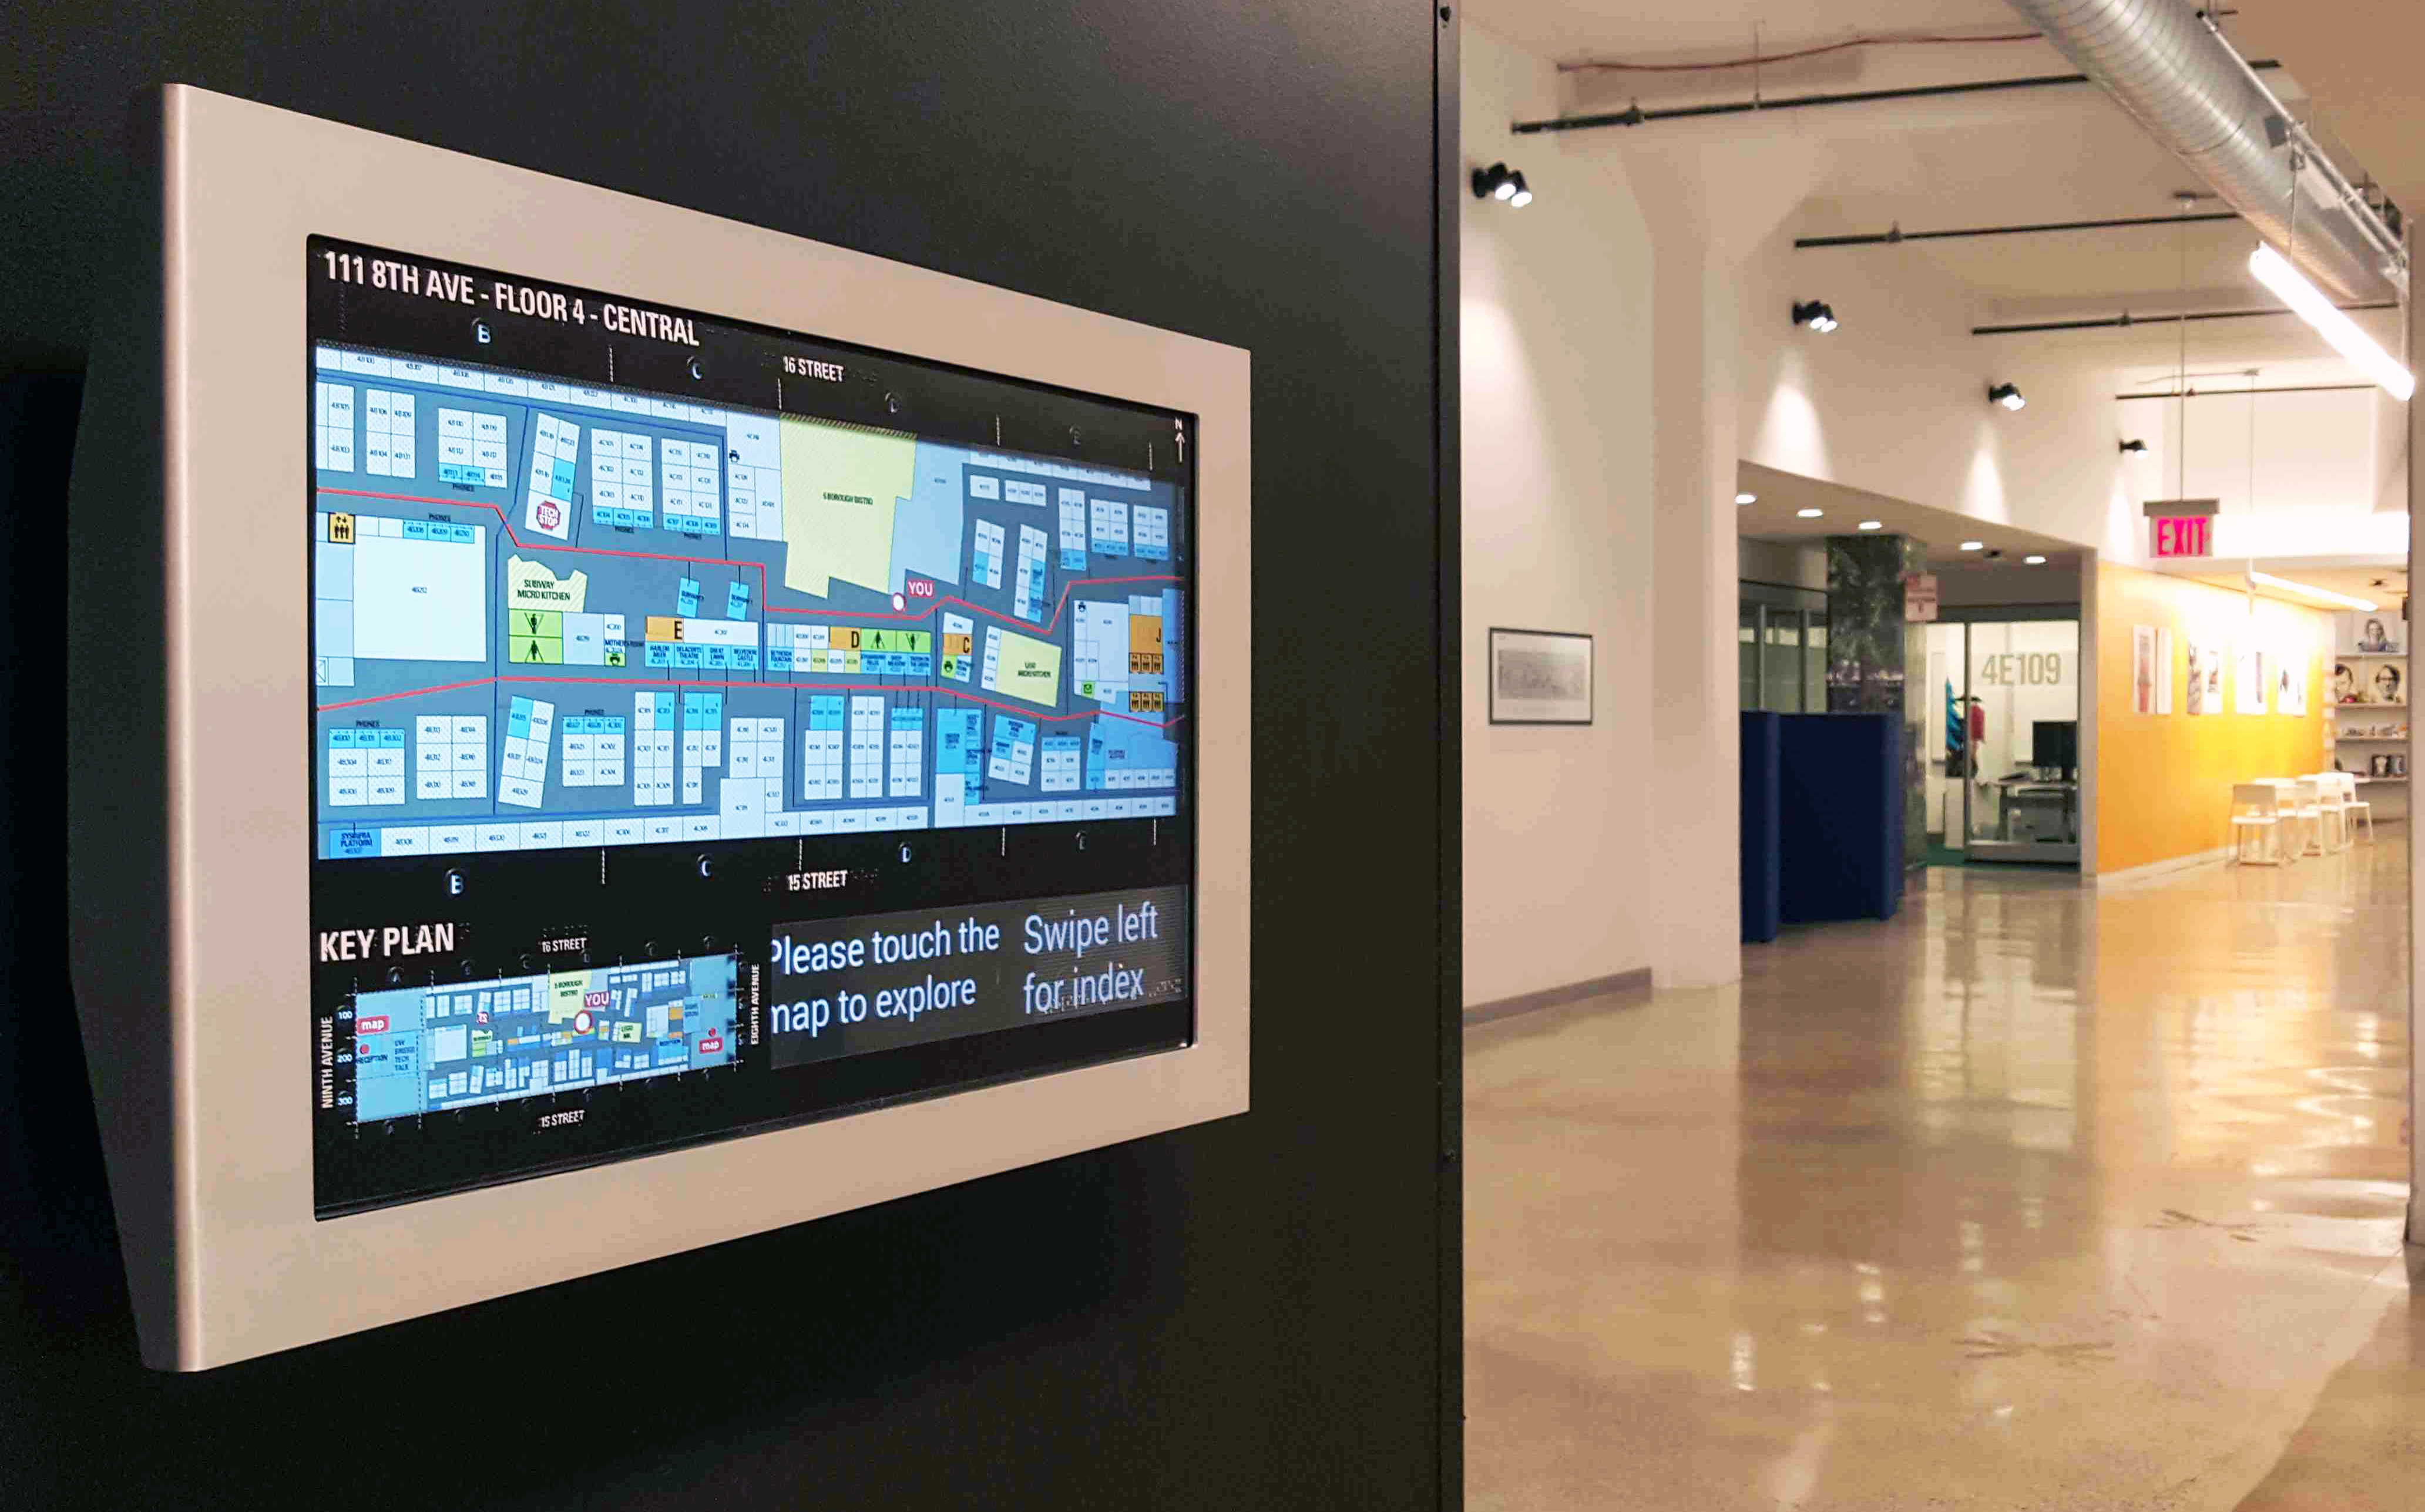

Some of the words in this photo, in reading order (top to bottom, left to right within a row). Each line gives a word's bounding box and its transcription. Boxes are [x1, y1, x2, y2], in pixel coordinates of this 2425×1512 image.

[325, 251, 363, 284] 111
[372, 260, 419, 295] 8TH
[425, 270, 474, 305] AVE
[495, 282, 567, 322] FLOOR
[572, 301, 585, 325] 4
[604, 303, 700, 347] CENTRAL
[478, 325, 491, 344] B
[783, 355, 795, 374] 16
[798, 358, 844, 382] STREET
[1175, 419, 1183, 430] N
[539, 503, 557, 516] TECH
[539, 515, 558, 525] STOP
[2157, 518, 2207, 557] EXIT
[517, 589, 540, 600] MICRO
[541, 591, 570, 601] KITCHEN
[908, 580, 933, 596] YOU
[674, 620, 682, 640] E
[1156, 628, 1161, 643] J
[851, 631, 860, 649] D
[962, 637, 970, 654] C
[1981, 652, 2062, 686] 4E109
[788, 875, 800, 891] 15
[802, 869, 848, 889] STREET
[1023, 908, 1109, 959] Swipe
[1117, 900, 1158, 941] left
[320, 929, 375, 962] KEY
[384, 923, 454, 956] PLAN
[552, 938, 586, 951] STREET
[872, 919, 951, 964] touch
[958, 916, 1000, 953] the
[750, 963, 760, 1002] AVENUE
[1024, 971, 1064, 1014] for
[1073, 962, 1144, 1007] index
[585, 992, 609, 1007] YOU
[837, 989, 867, 1023] to
[875, 973, 976, 1022] explore
[338, 1010, 352, 1020] 100
[361, 1019, 385, 1032] map
[320, 1016, 333, 1068] AVENUE
[702, 1040, 720, 1051] map
[320, 1071, 333, 1108] NINTH
[541, 1115, 550, 1128] 15
[551, 1110, 585, 1125] STREET
